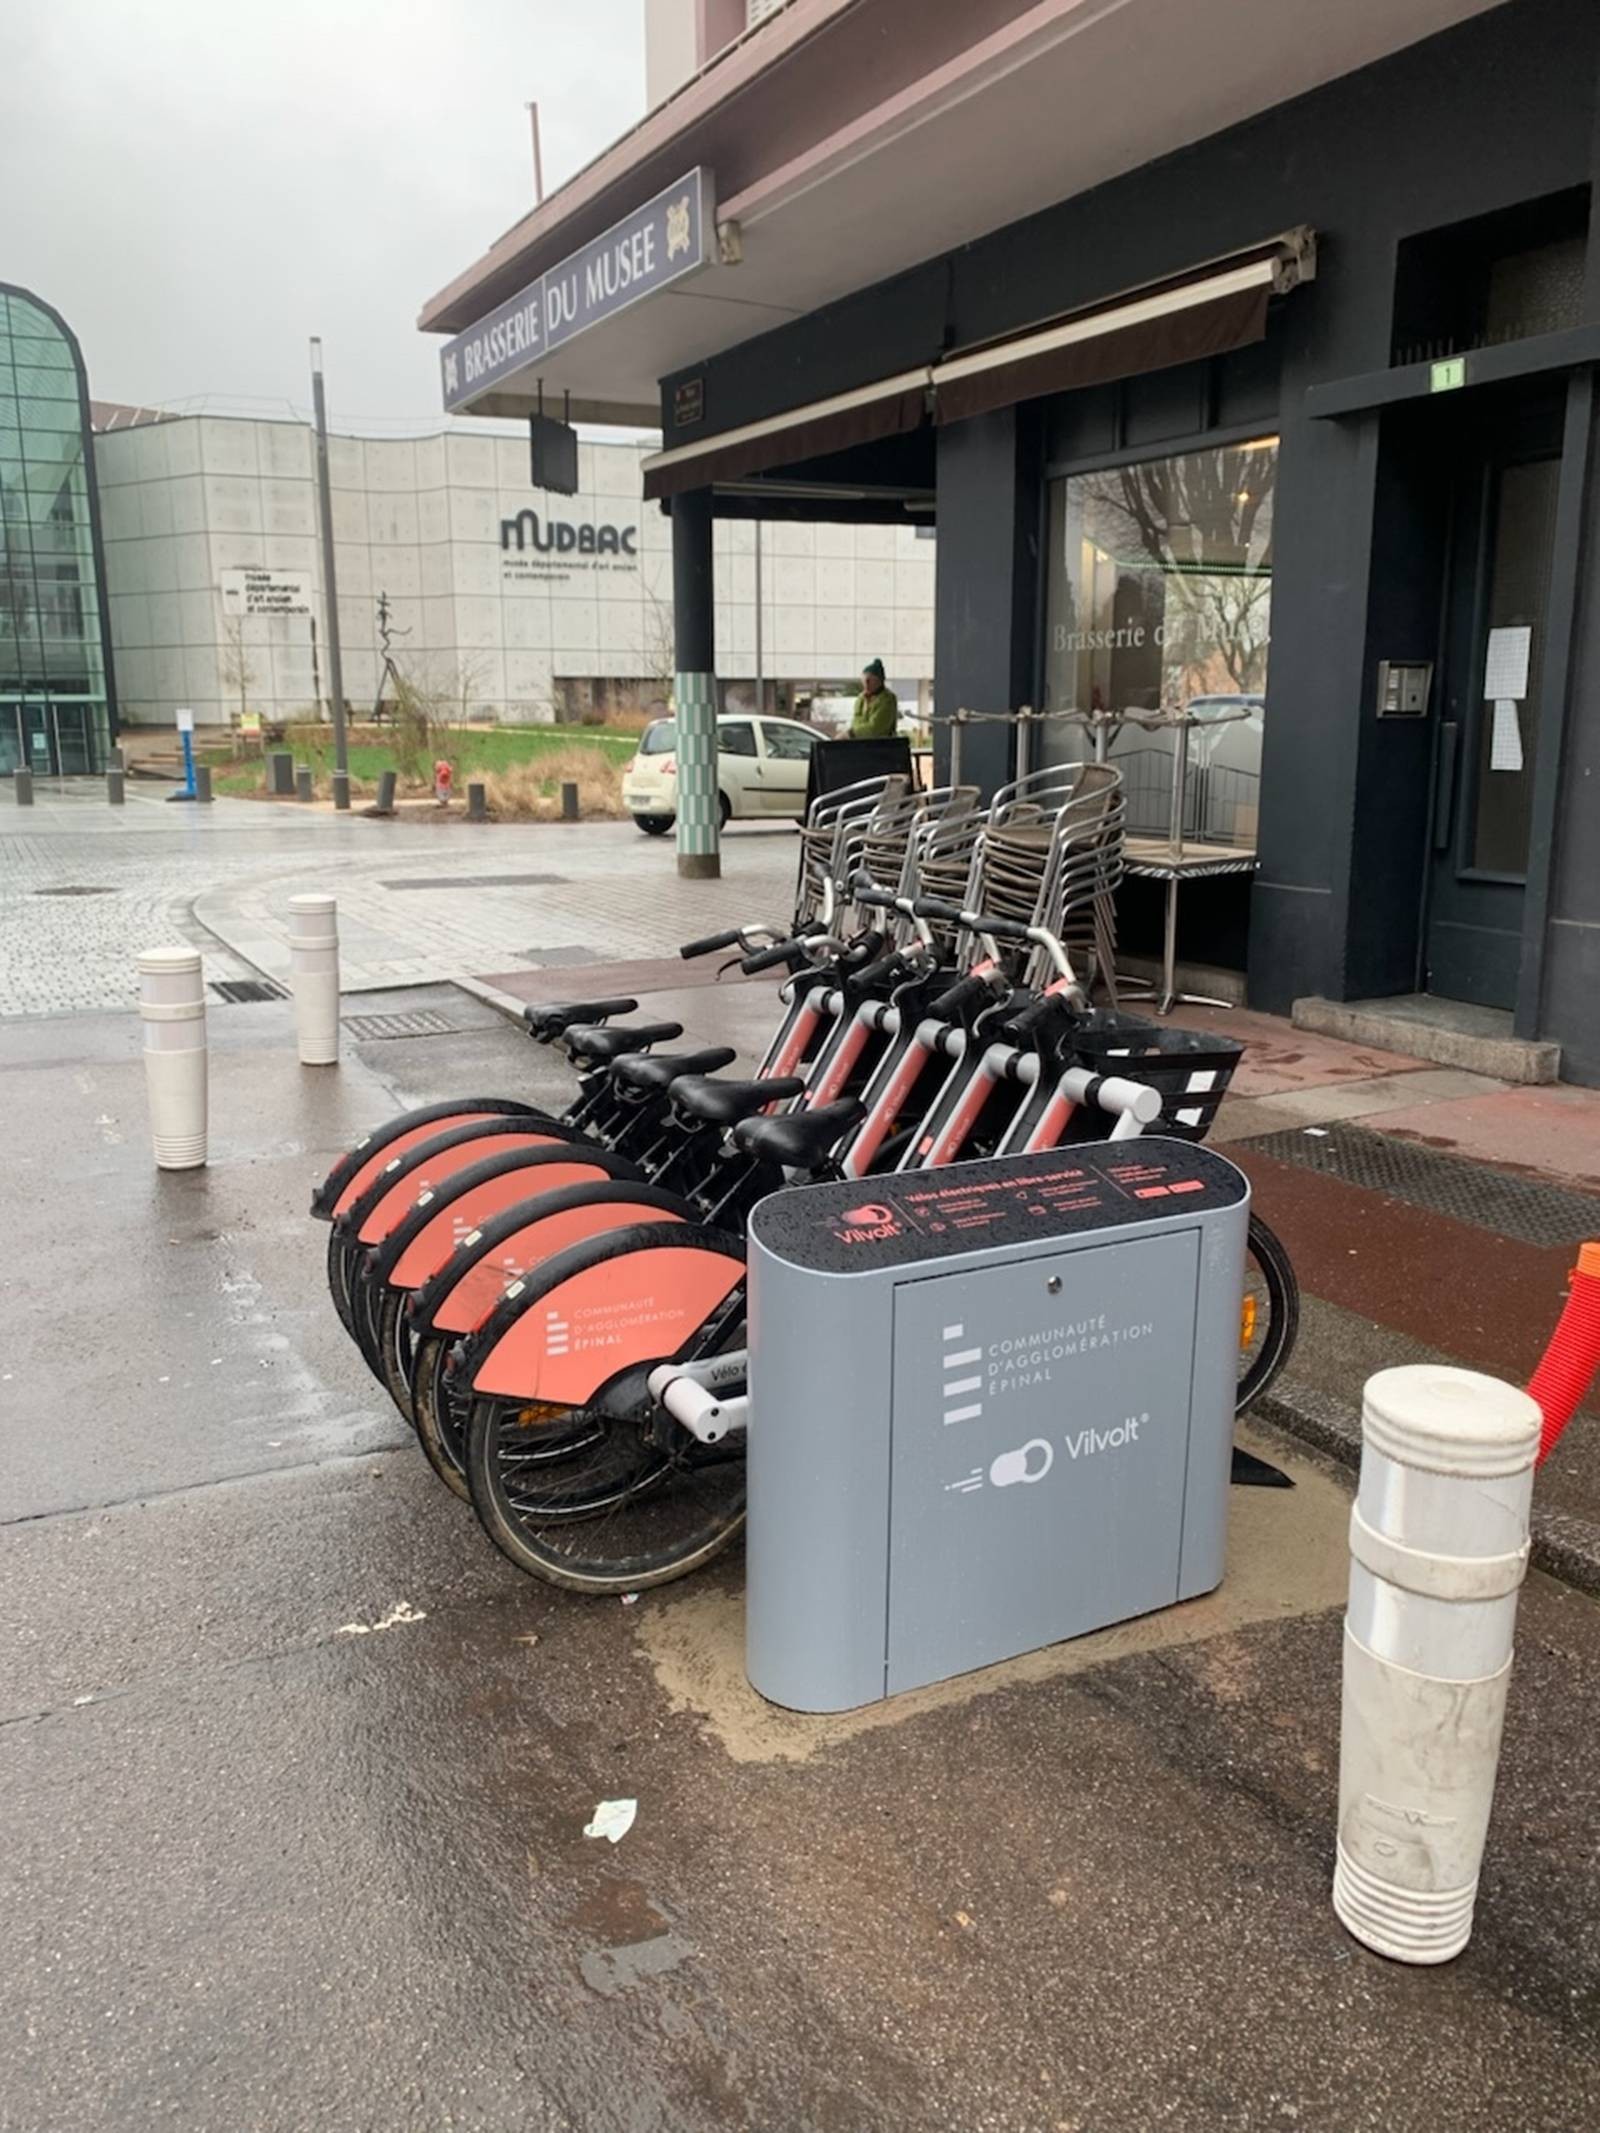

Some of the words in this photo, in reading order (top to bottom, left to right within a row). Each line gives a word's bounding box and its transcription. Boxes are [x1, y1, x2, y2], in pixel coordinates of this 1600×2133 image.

[463, 302, 539, 382] BRASSERIE
[547, 273, 578, 331] DU
[586, 222, 655, 309] MUSEE
[1053, 617, 1145, 651] Brasserie
[833, 1223, 900, 1244] Vilvolt
[987, 1322, 1153, 1377] D'AGGLOMÉRATION
[988, 1314, 1106, 1357] COMMUNAUTÉ
[988, 1367, 1052, 1396] ÉPINAL
